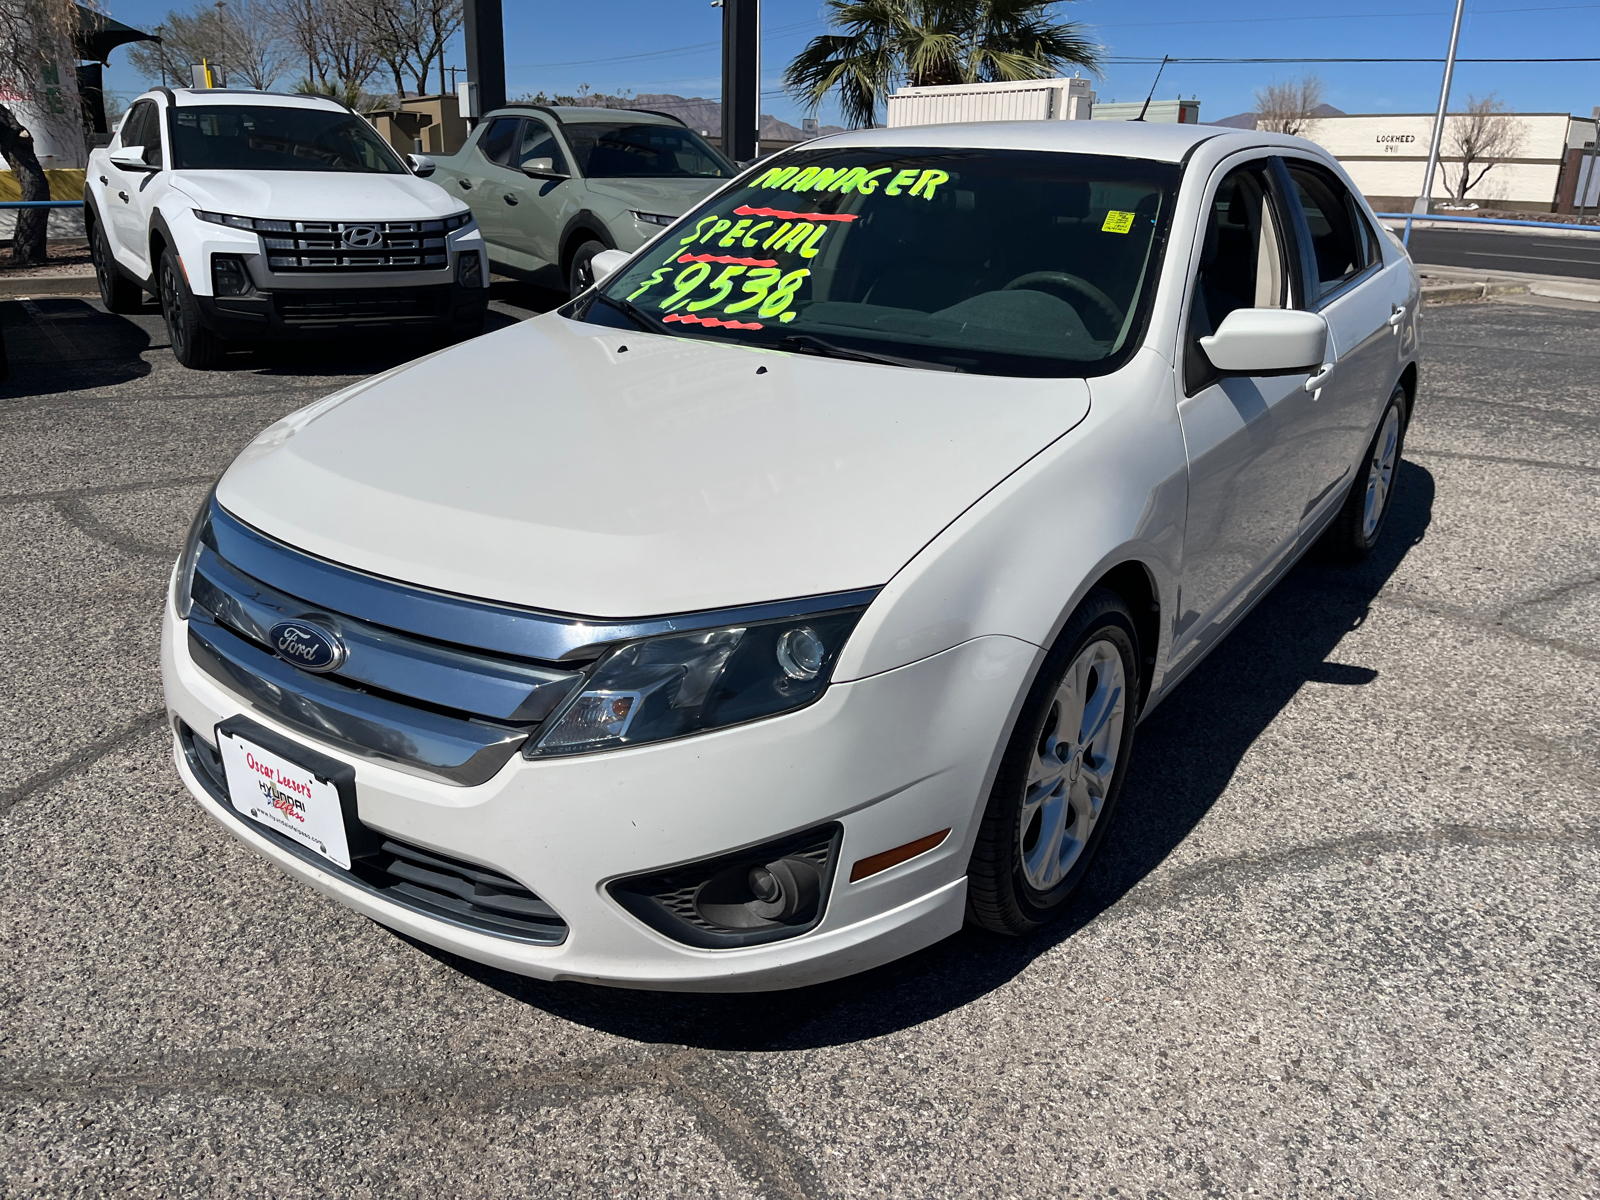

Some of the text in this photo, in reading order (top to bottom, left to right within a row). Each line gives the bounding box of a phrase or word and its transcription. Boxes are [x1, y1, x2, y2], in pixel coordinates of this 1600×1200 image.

[1376, 134, 1416, 144] LOCKHEED
[1384, 144, 1399, 154] 8411
[747, 166, 950, 201] MANAGER
[679, 214, 828, 259] SPECIAL
[278, 627, 320, 661] Ford
[246, 752, 312, 799] Oscar Leeser's
[258, 779, 306, 812] HYUNDAI
[273, 799, 286, 809] El
[285, 803, 305, 822] Paso
